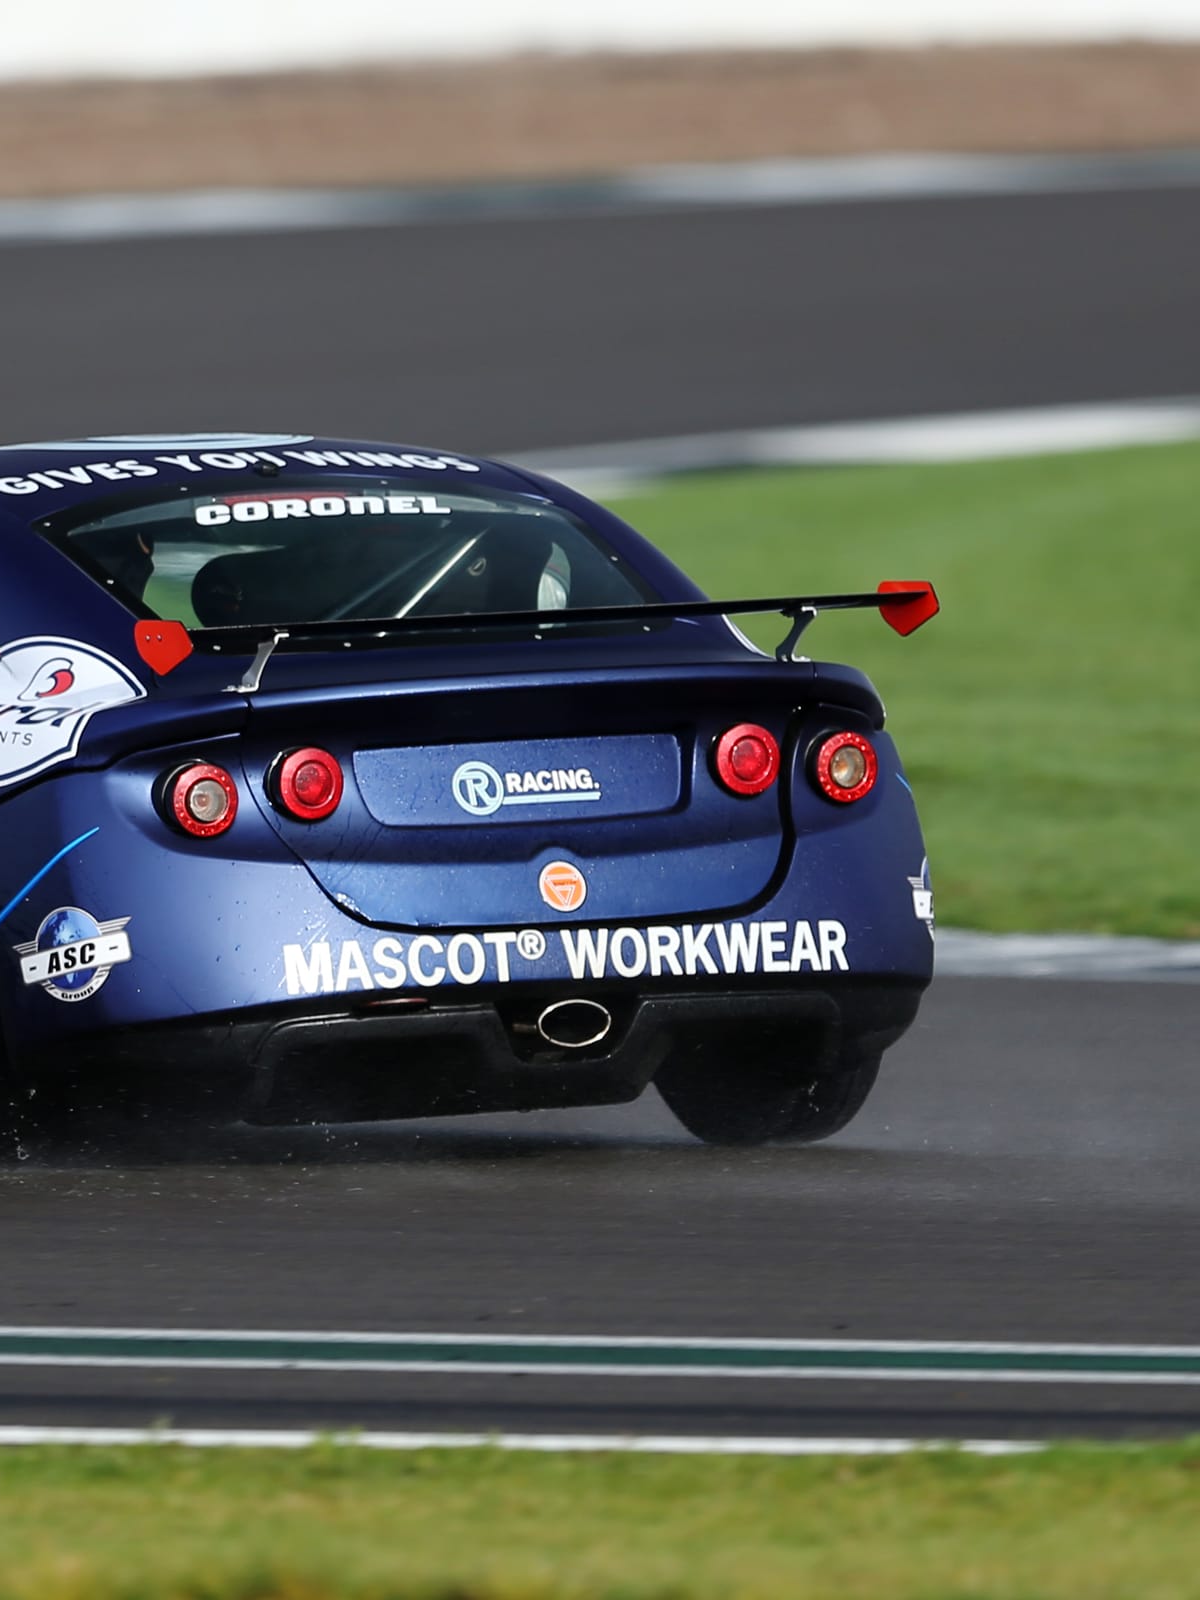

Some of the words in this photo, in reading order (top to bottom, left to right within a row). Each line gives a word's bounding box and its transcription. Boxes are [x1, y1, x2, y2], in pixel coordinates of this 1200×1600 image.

[155, 453, 287, 472] YOU
[282, 451, 480, 473] WINGS
[195, 496, 451, 526] CORONEL
[505, 768, 599, 793] RACING.
[48, 943, 95, 974] ASC
[561, 920, 850, 979] WORKWEAR
[61, 986, 94, 1000] Group
